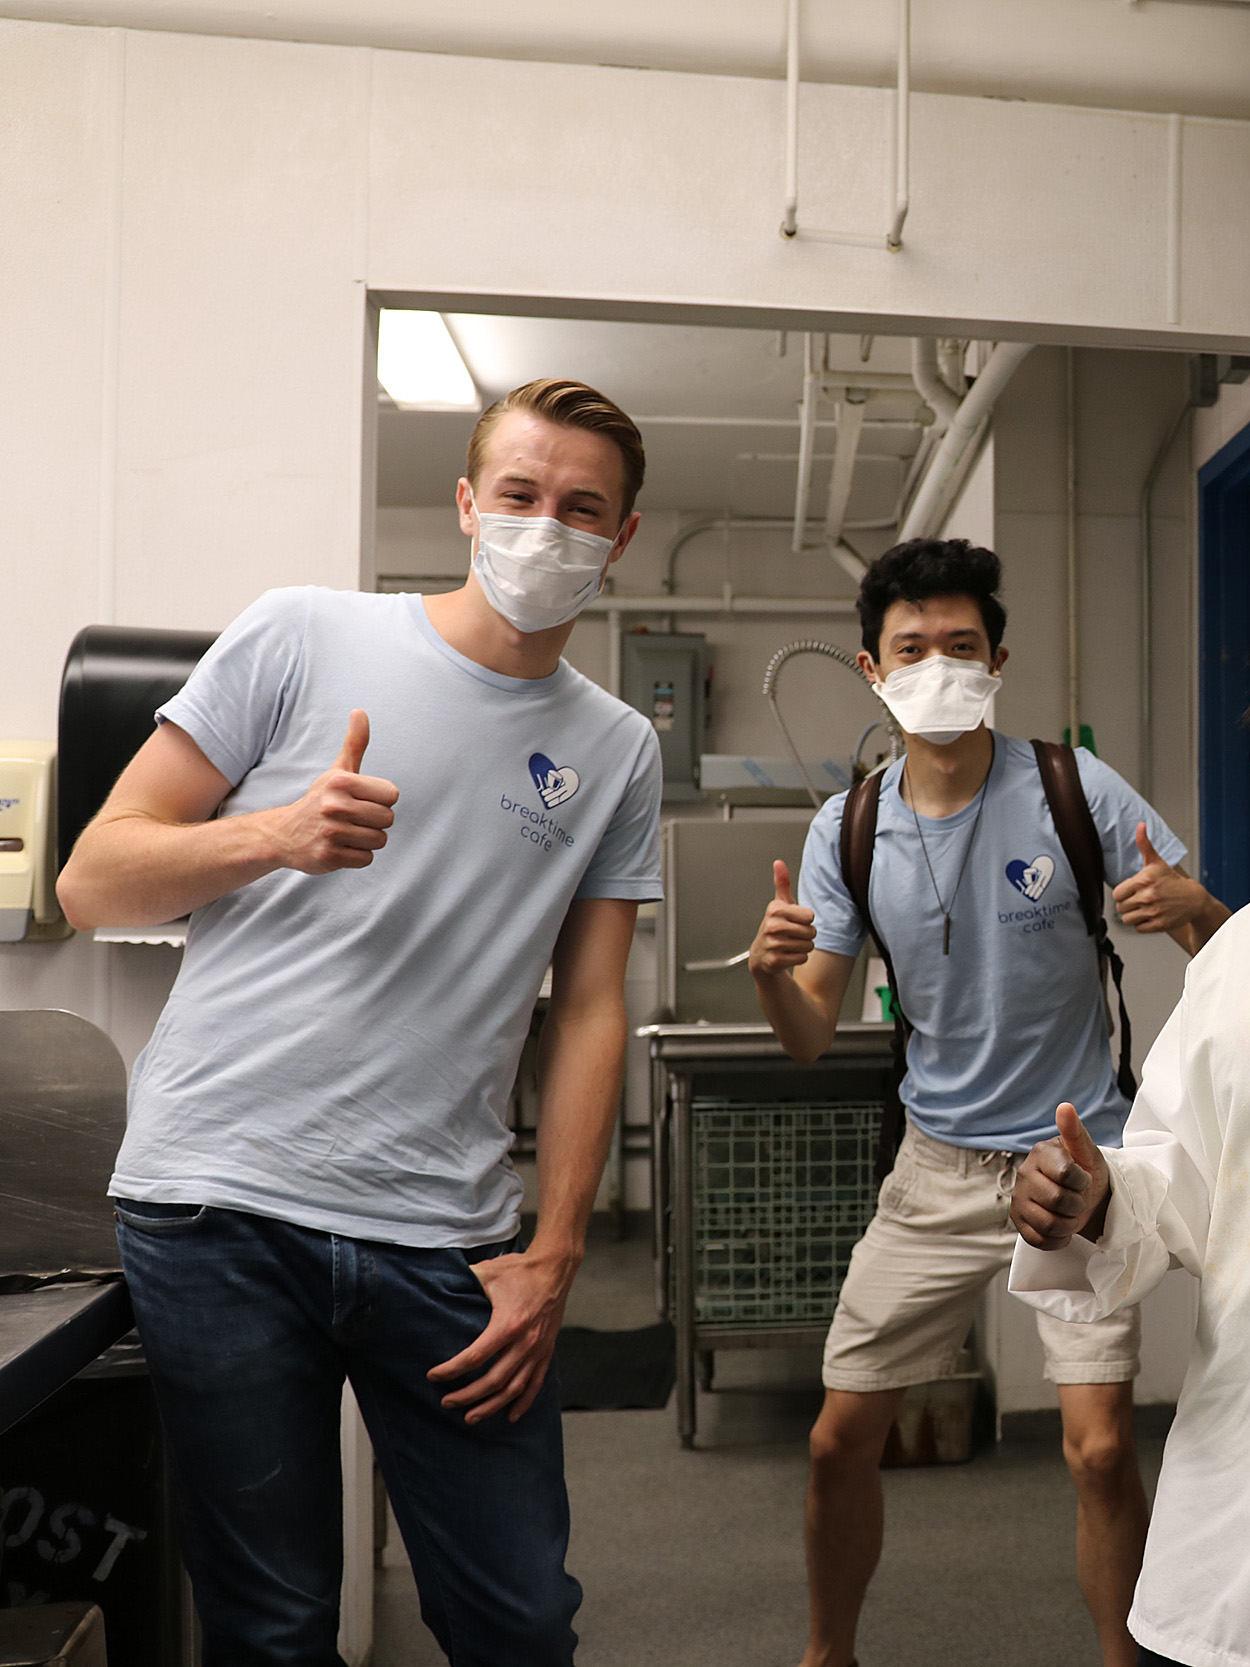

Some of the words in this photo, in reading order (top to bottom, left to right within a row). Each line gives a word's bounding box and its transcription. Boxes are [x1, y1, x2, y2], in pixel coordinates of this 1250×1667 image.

[500, 794, 575, 848] breaktime
[520, 826, 553, 852] cafe
[998, 901, 1072, 925] breaktime
[1023, 918, 1056, 934] cafe
